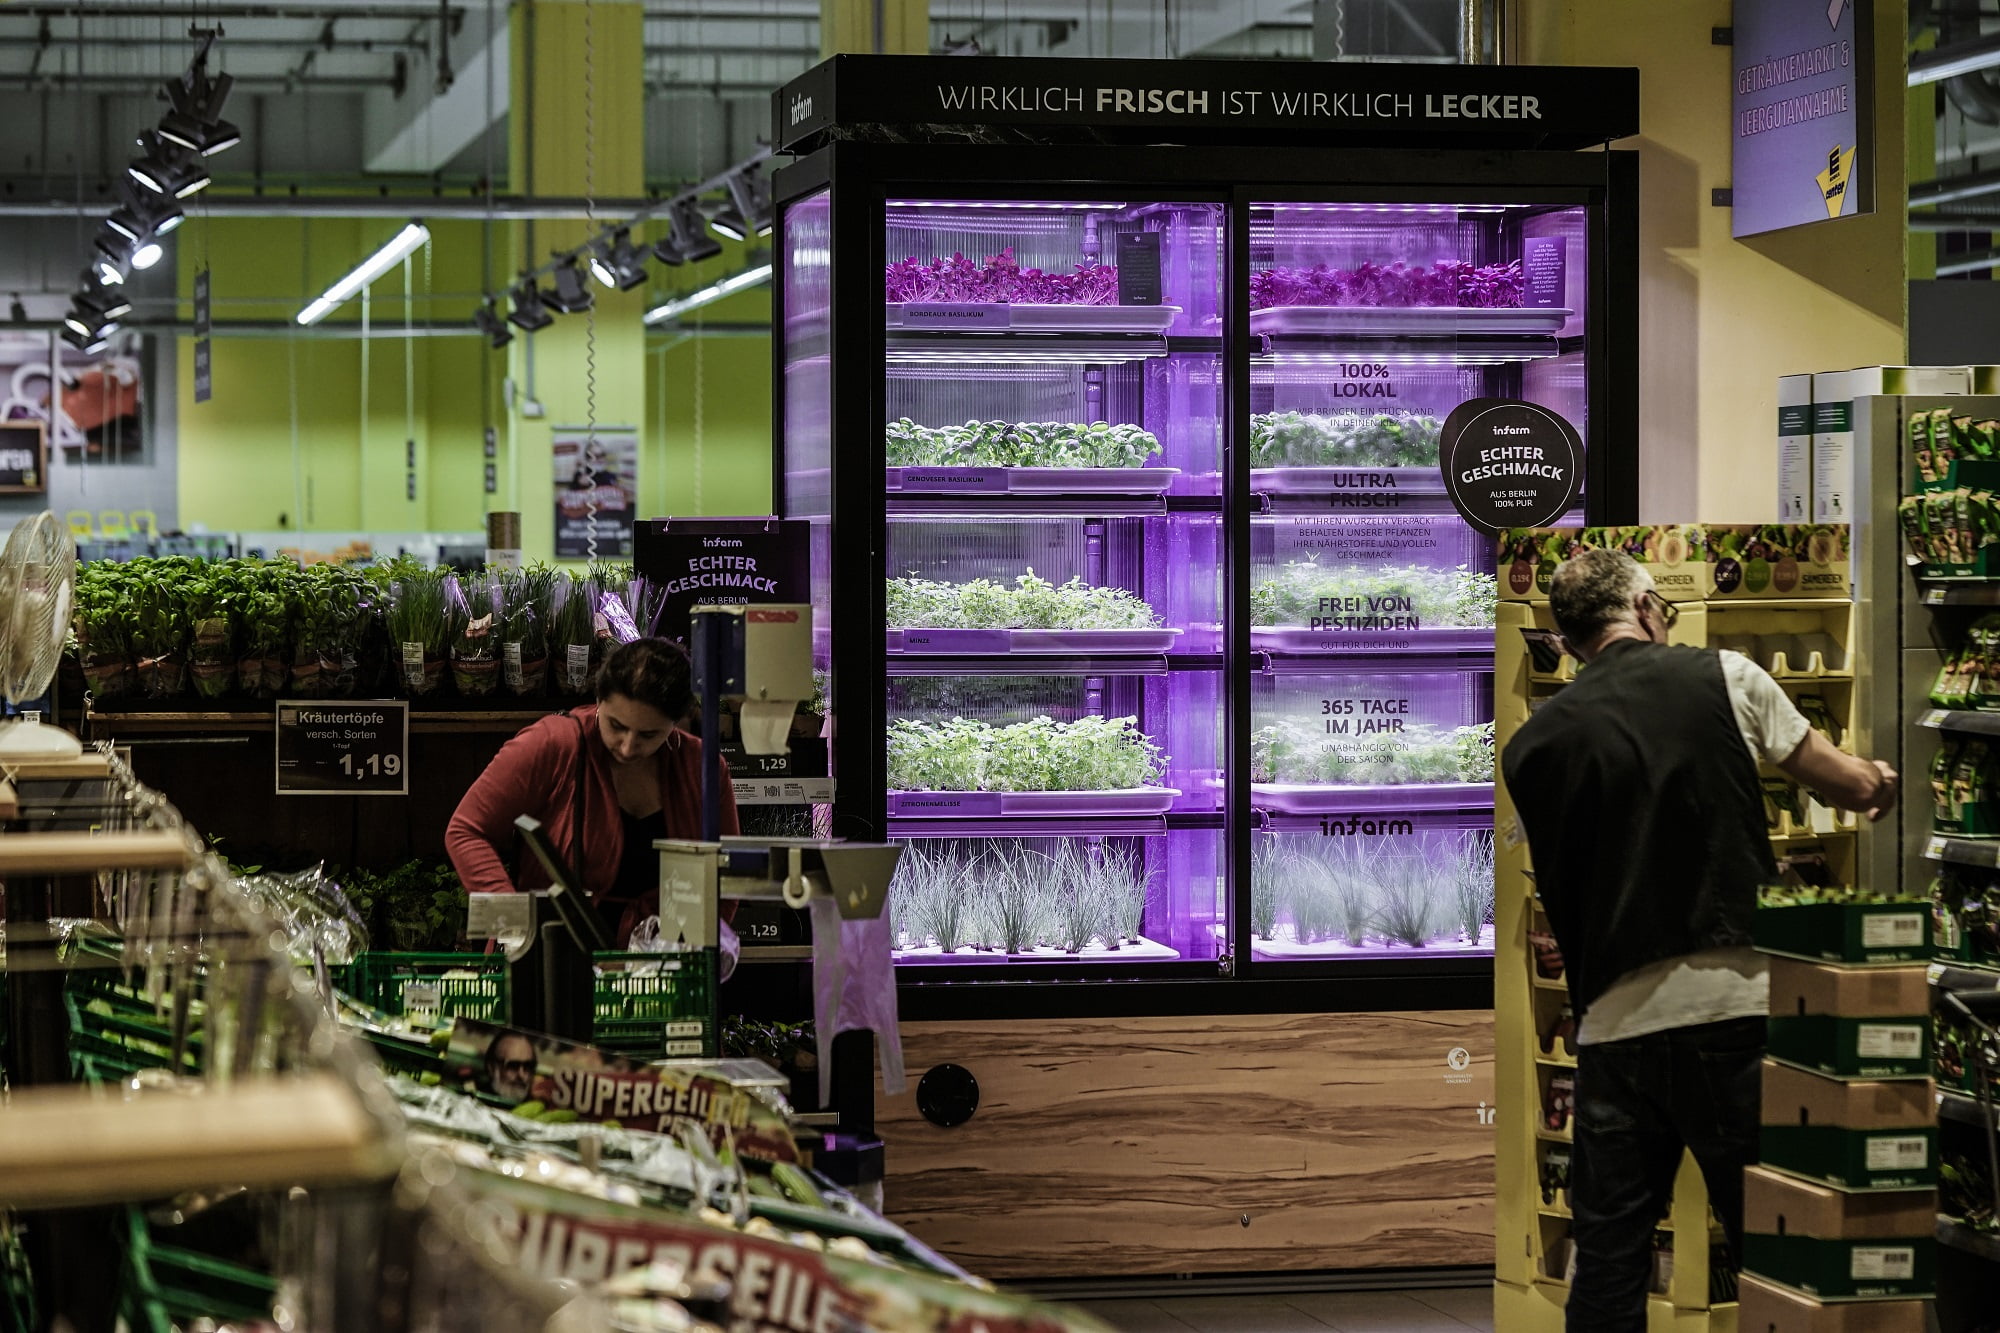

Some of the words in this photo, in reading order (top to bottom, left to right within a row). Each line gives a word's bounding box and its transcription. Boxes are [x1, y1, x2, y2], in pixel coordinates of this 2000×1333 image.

[1738, 42, 1838, 95] GETRÄNKEMARKT
[938, 85, 1083, 111] WIRKLICH
[1096, 88, 1208, 114] FRISCH
[1222, 91, 1262, 115] IST
[1271, 91, 1412, 117] WIRKLICH
[1425, 94, 1542, 119] LECKER
[1740, 84, 1848, 138] LEERGUTANNAHME
[1339, 363, 1390, 379] 100%
[1333, 382, 1397, 398] LOKAL
[1316, 407, 1357, 416] BRINGEN
[1360, 407, 1375, 416] EIN
[1378, 405, 1407, 416] STÜCK
[1409, 407, 1434, 416] LAND
[1330, 419, 1339, 427] IN
[1343, 419, 1377, 427] DEINEN
[1492, 425, 1530, 436] infarm
[1480, 446, 1544, 463] ECHTER
[1333, 473, 1397, 488] ULTRA
[1461, 462, 1564, 484] GESCHMACK
[1330, 492, 1399, 507] FRISCH
[1490, 490, 1507, 499] AUS
[1508, 489, 1537, 498] BERLIN
[1494, 500, 1515, 508] 100%
[1516, 499, 1534, 507] PUR
[1295, 517, 1312, 525] MIT
[1313, 517, 1342, 525] IHREN
[1345, 517, 1388, 525] WURZELN
[1391, 517, 1435, 525] VERPACKT
[1299, 528, 1344, 537] BEHALTEN
[1347, 528, 1383, 536] UNSERE
[1385, 528, 1431, 536] PFLANZEN
[702, 537, 743, 547] infarm
[1293, 540, 1314, 548] IHRE
[1317, 538, 1376, 548] NÄHRSTOFFE
[1379, 540, 1399, 548] UND
[1402, 540, 1437, 548] VOLLEN
[1336, 551, 1393, 559] GESCHMACK
[688, 555, 757, 572] ECHTER
[668, 573, 778, 594] GESCHMACK
[697, 596, 715, 605] AUS
[717, 596, 749, 605] BERLIN
[1318, 597, 1360, 612] FREI
[1368, 597, 1411, 612] VON
[1310, 616, 1420, 632] PESTIZIDEN
[1321, 641, 1338, 649] GUT
[1342, 640, 1360, 649] FÜR
[1363, 641, 1385, 649] DICH
[1388, 641, 1409, 649] UND
[1321, 699, 1354, 715] 365
[1360, 699, 1409, 714] TAGE
[299, 711, 384, 726] Kräutertöpfe
[306, 730, 341, 739] versch.
[344, 729, 377, 739] Sorten
[1326, 719, 1349, 734] IM
[1355, 718, 1405, 737] JAHR
[1321, 742, 1386, 752] UNABHÄNGIG
[1387, 743, 1409, 751] VON
[339, 753, 401, 780] 1,19
[759, 758, 787, 771] 1,29
[1337, 755, 1356, 764] DER
[1359, 755, 1394, 764] SAISON
[1319, 814, 1413, 836] infarm
[750, 924, 778, 938] 1,29
[553, 1068, 710, 1118] SUPERGEIL
